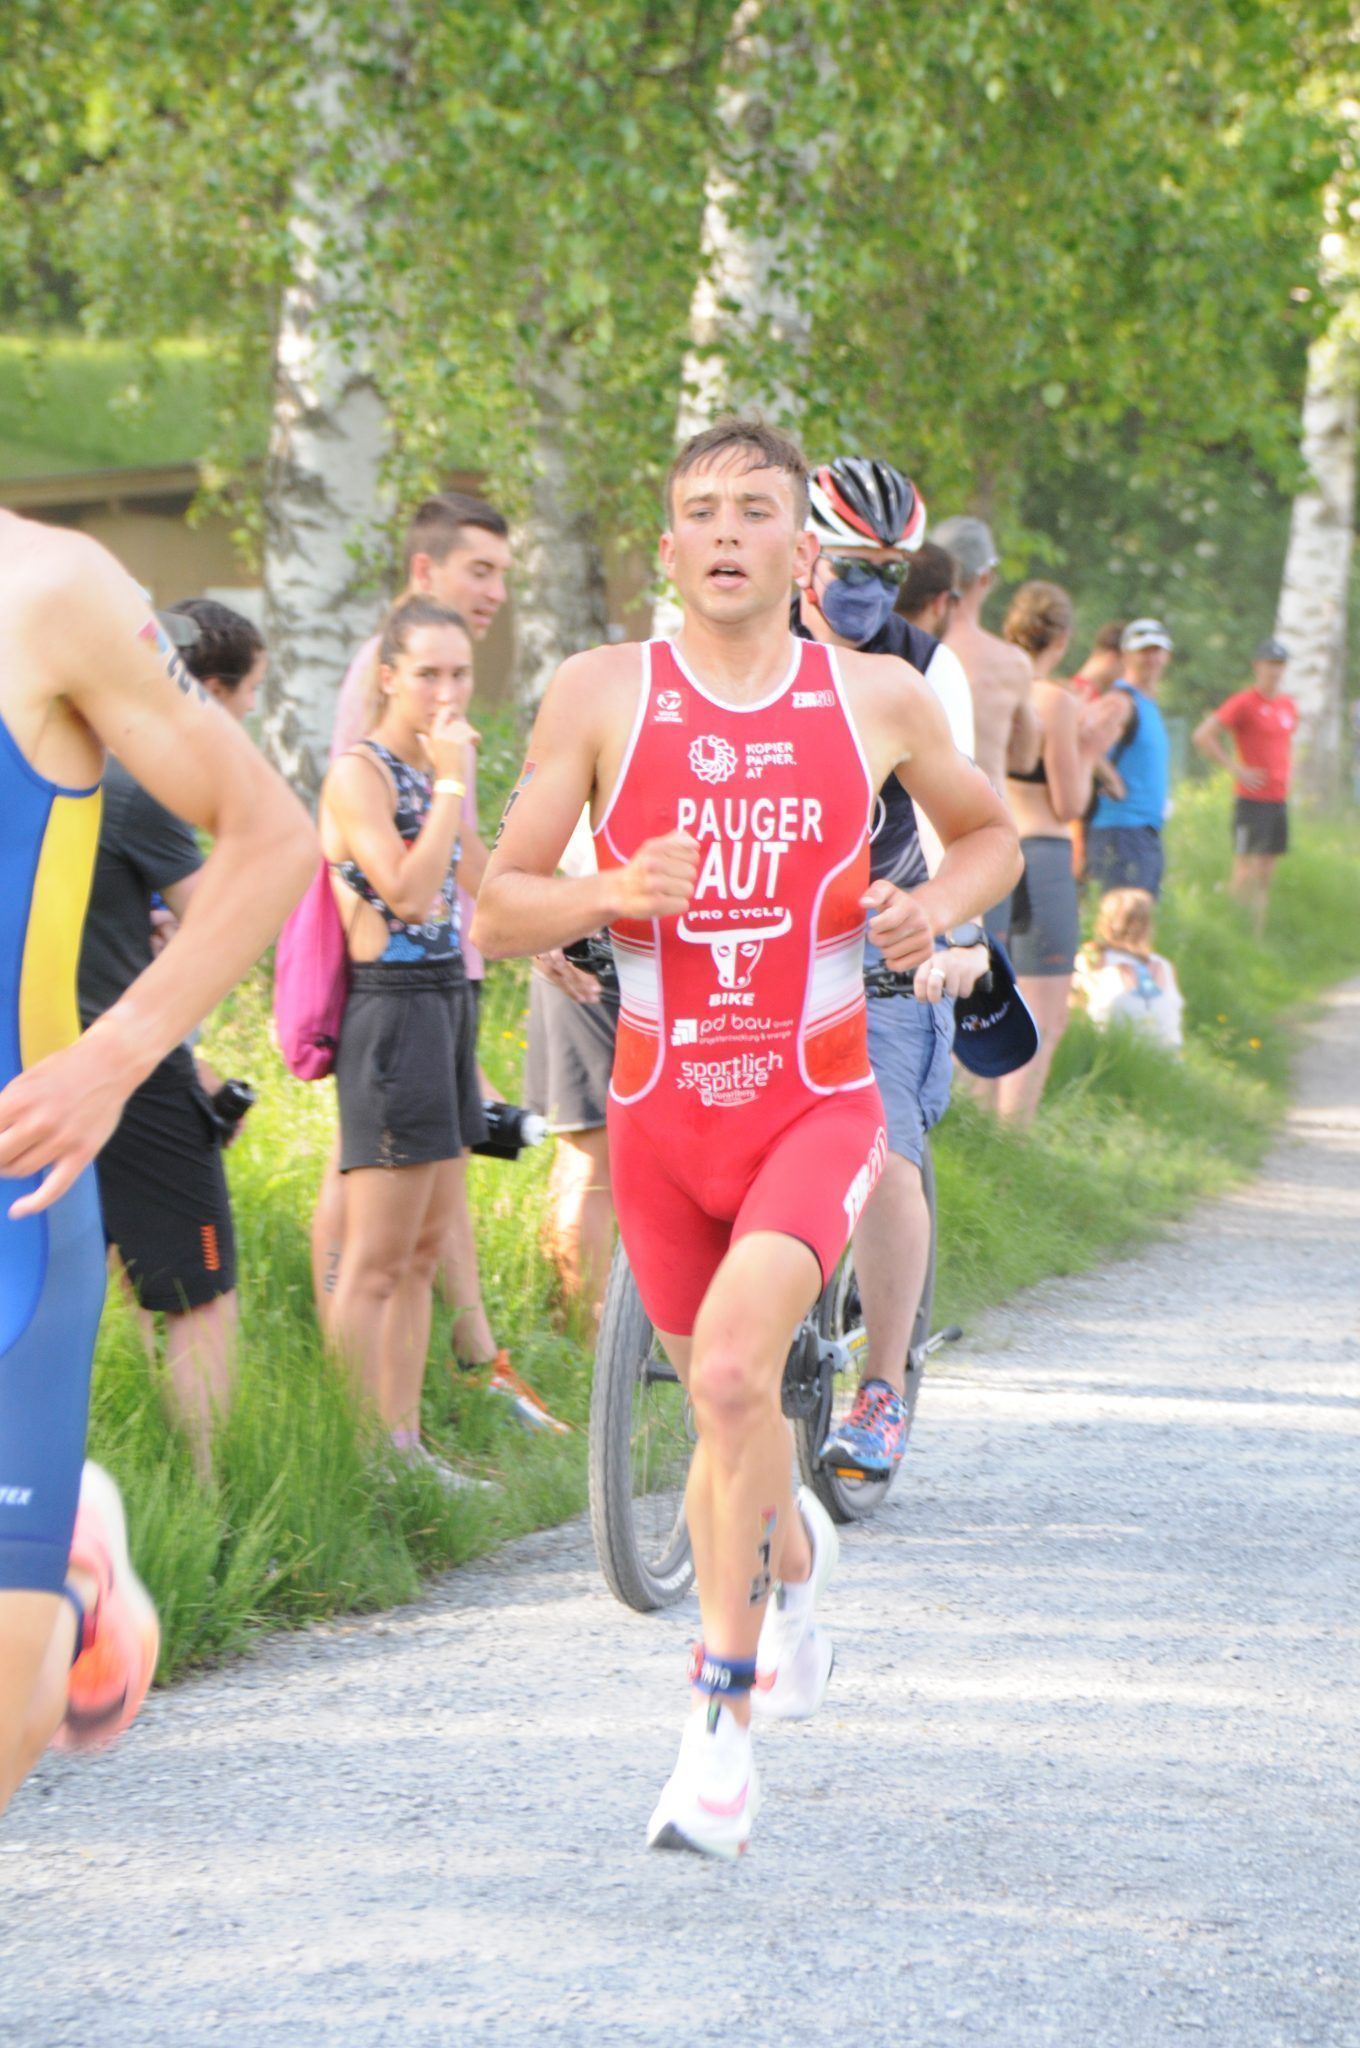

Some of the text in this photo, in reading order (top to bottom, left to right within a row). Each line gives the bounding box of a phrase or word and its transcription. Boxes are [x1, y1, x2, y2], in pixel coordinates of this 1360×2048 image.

[745, 742, 793, 755] KOPIER
[745, 754, 797, 767] PAPIER.
[745, 767, 763, 779] AT
[677, 797, 823, 843] PAUGER
[694, 841, 788, 900] AUT
[687, 906, 784, 921] PRO CYCLE
[708, 992, 755, 1007] BIKE
[700, 1013, 726, 1036] pd
[731, 1013, 771, 1030] bau
[681, 1050, 783, 1082] sportlich
[699, 1071, 769, 1092] spitze
